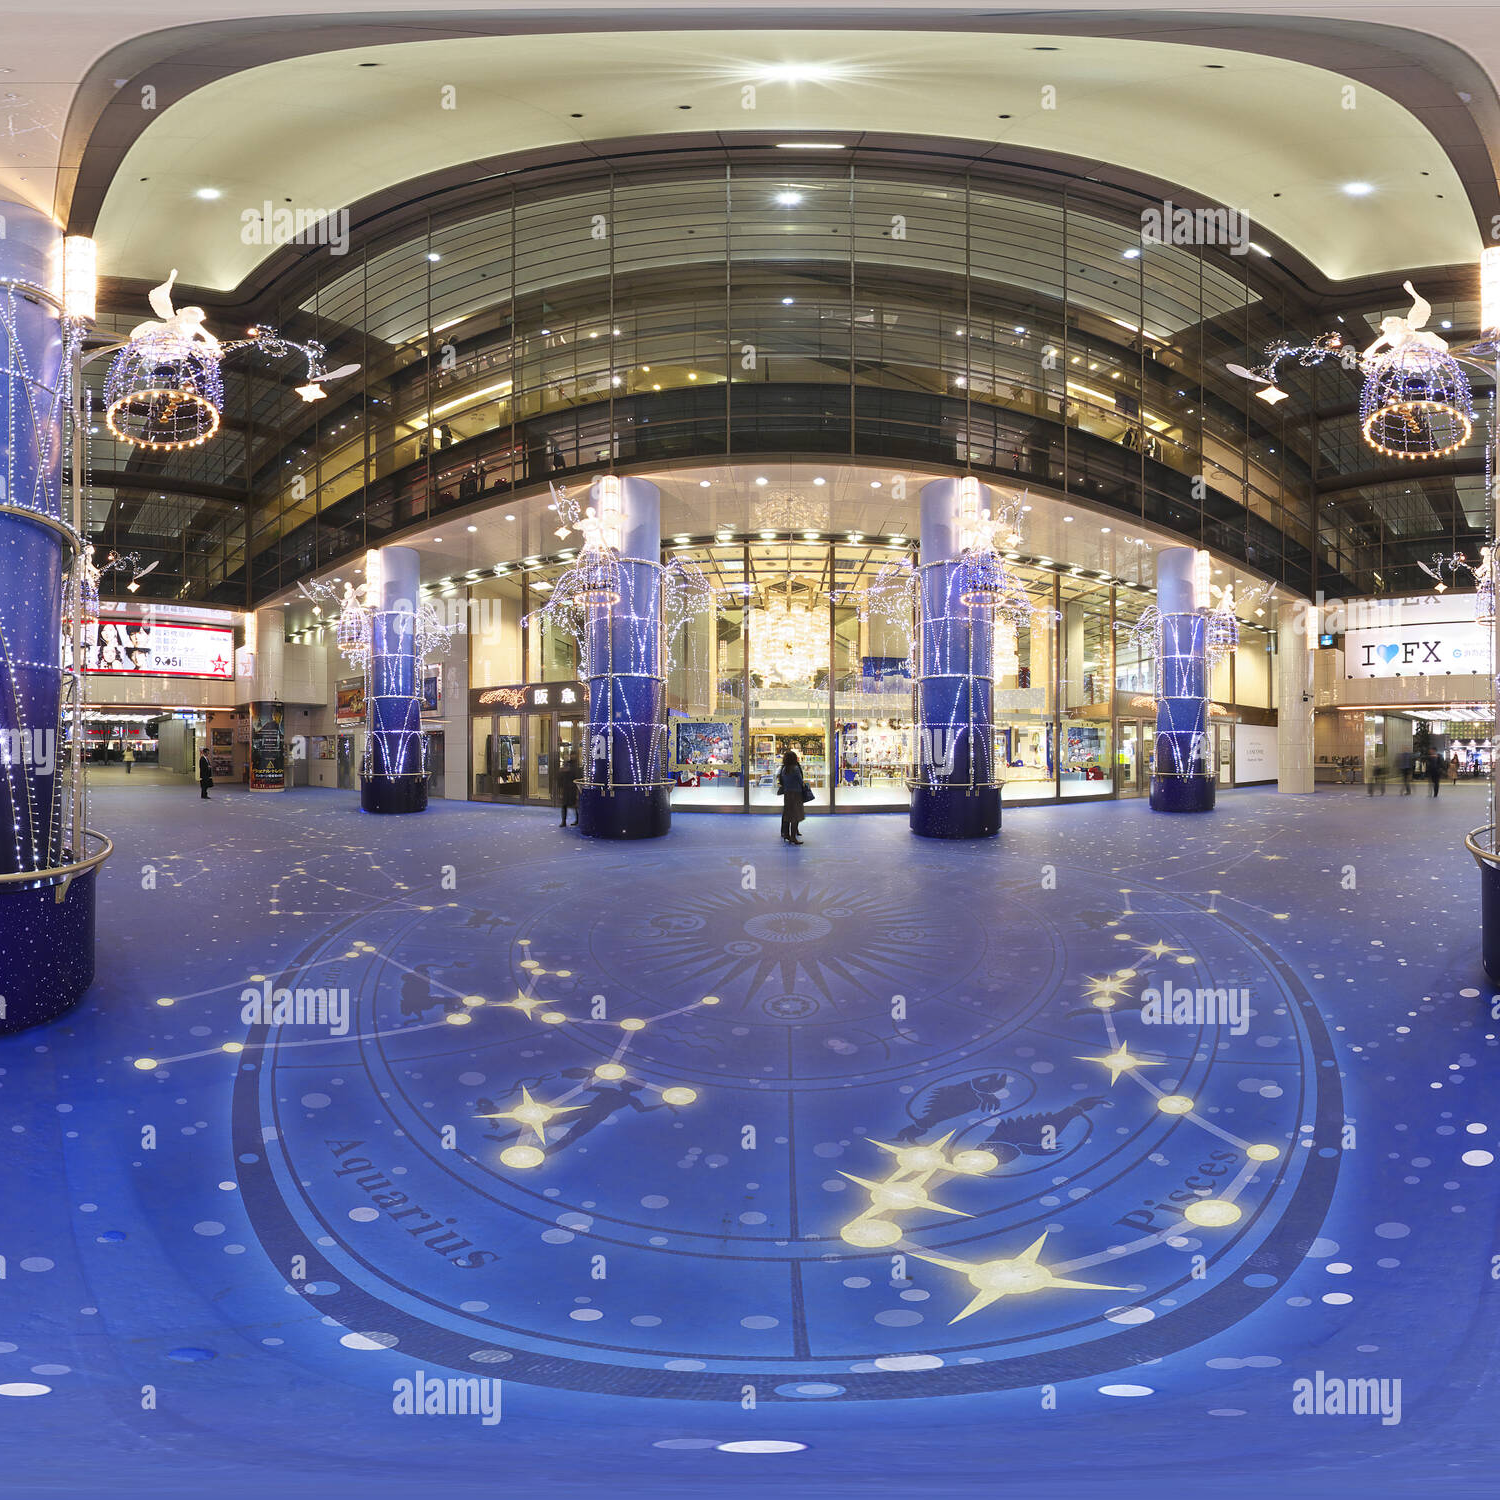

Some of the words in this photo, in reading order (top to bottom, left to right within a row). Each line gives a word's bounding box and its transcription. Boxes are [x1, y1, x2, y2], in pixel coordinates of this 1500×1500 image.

[1362, 645, 1375, 666] I
[1402, 641, 1441, 664] FX
[534, 688, 576, 704] 阪急
[324, 1138, 502, 1269] Aquarius
[1113, 1151, 1239, 1239] Pisces
